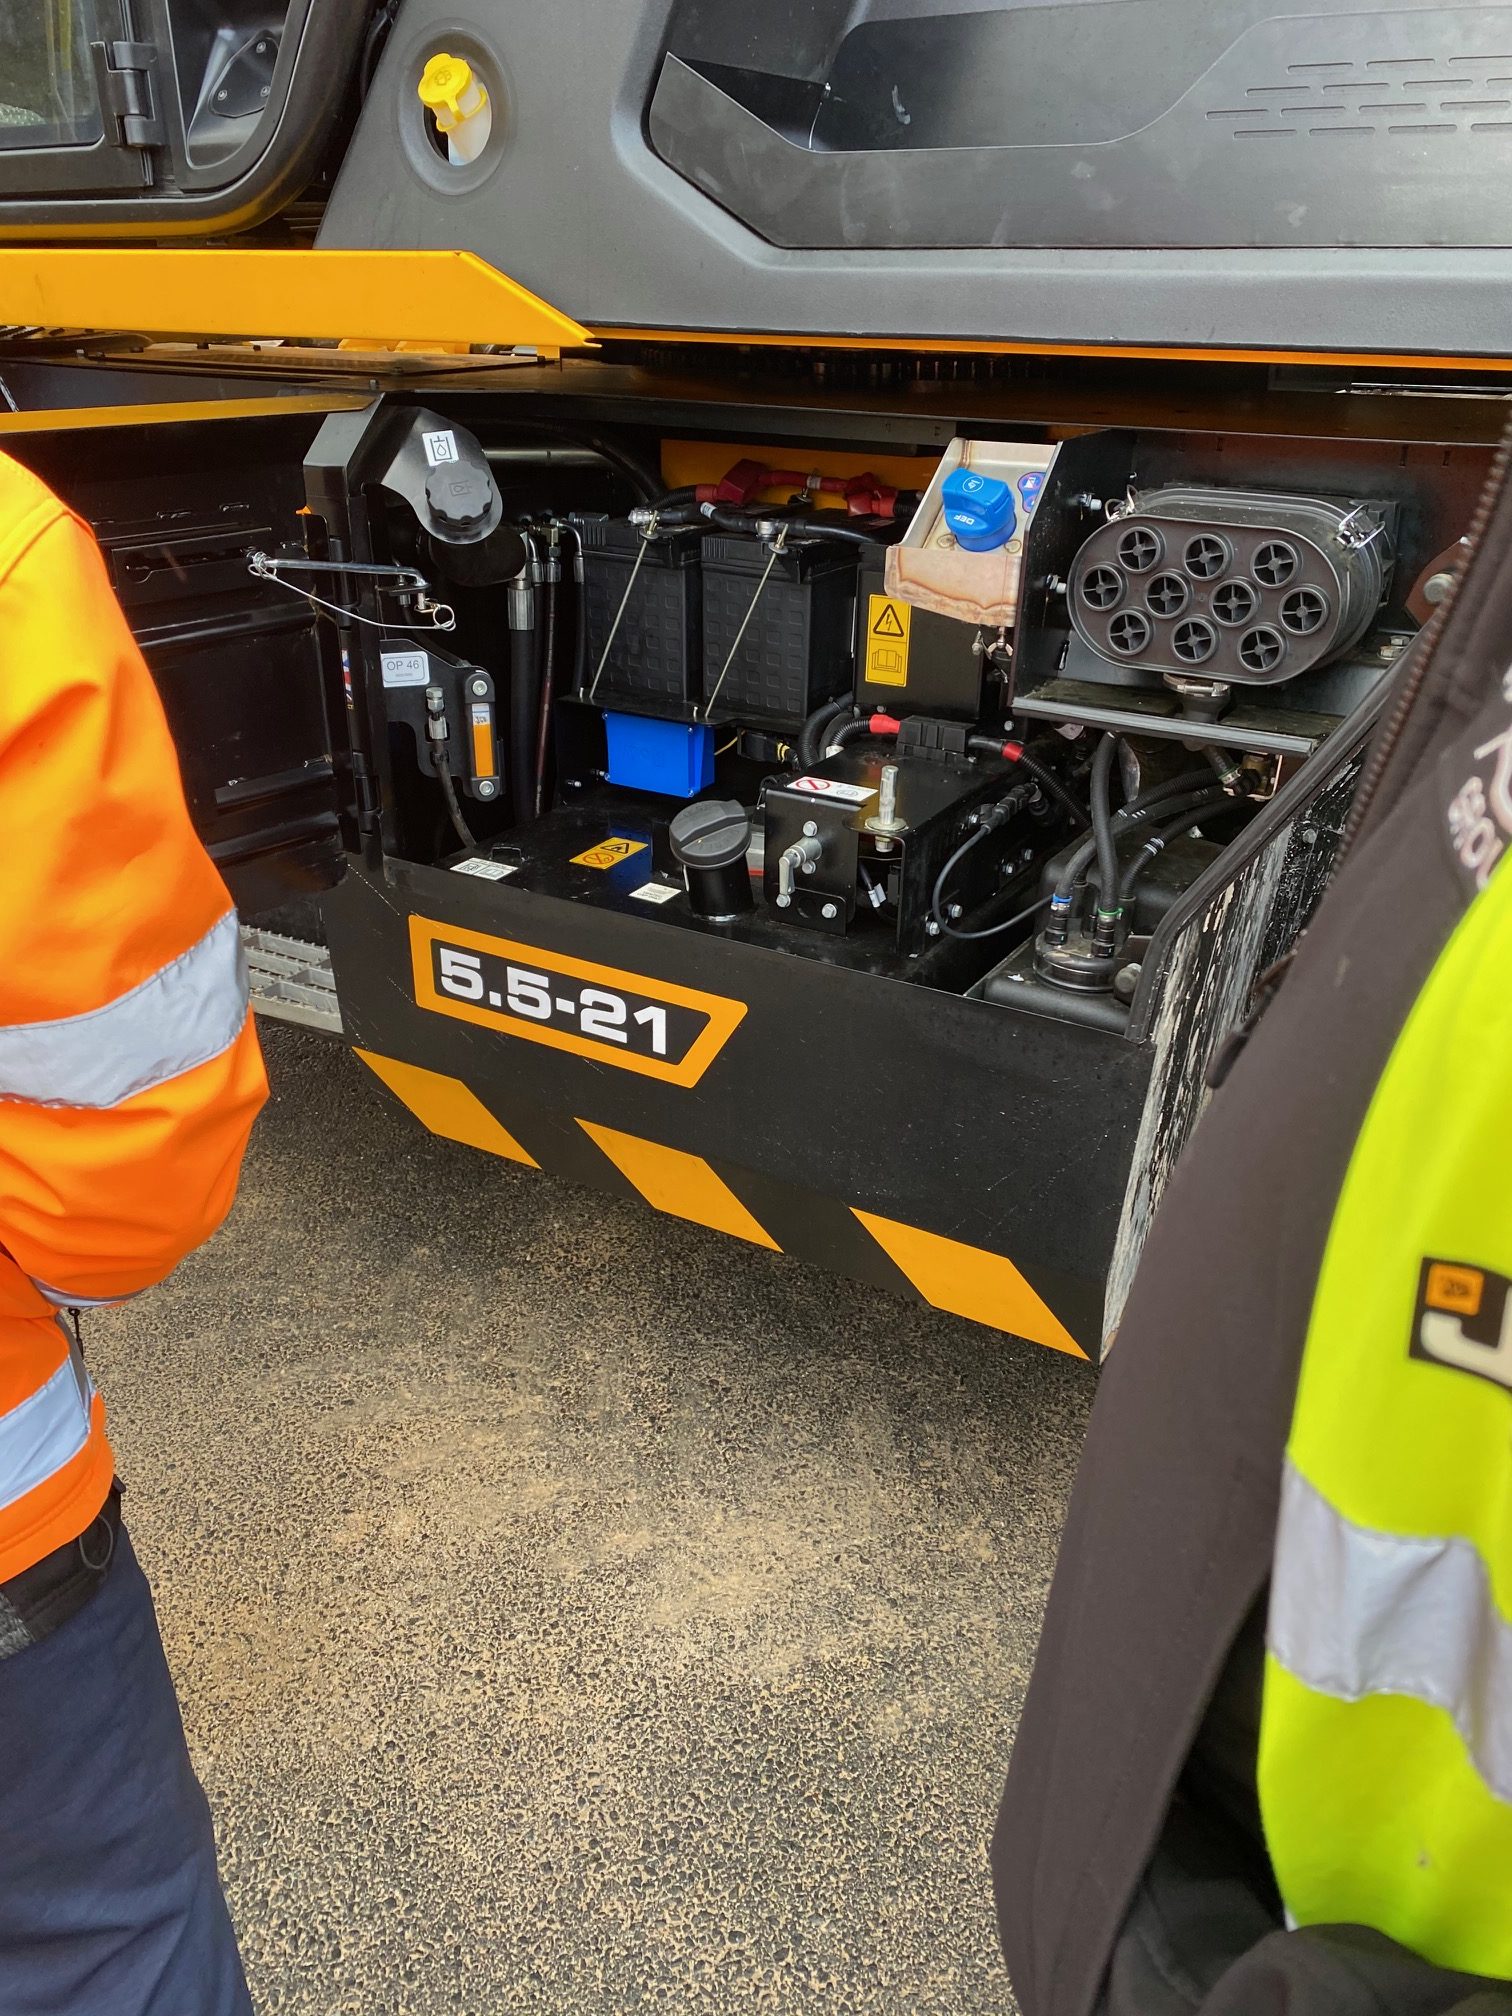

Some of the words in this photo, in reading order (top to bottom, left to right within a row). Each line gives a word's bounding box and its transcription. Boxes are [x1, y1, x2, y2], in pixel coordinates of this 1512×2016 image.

[954, 514, 975, 525] DEF
[386, 661, 403, 671] OP
[406, 660, 420, 670] 46
[439, 947, 667, 1056] 5.5-21
